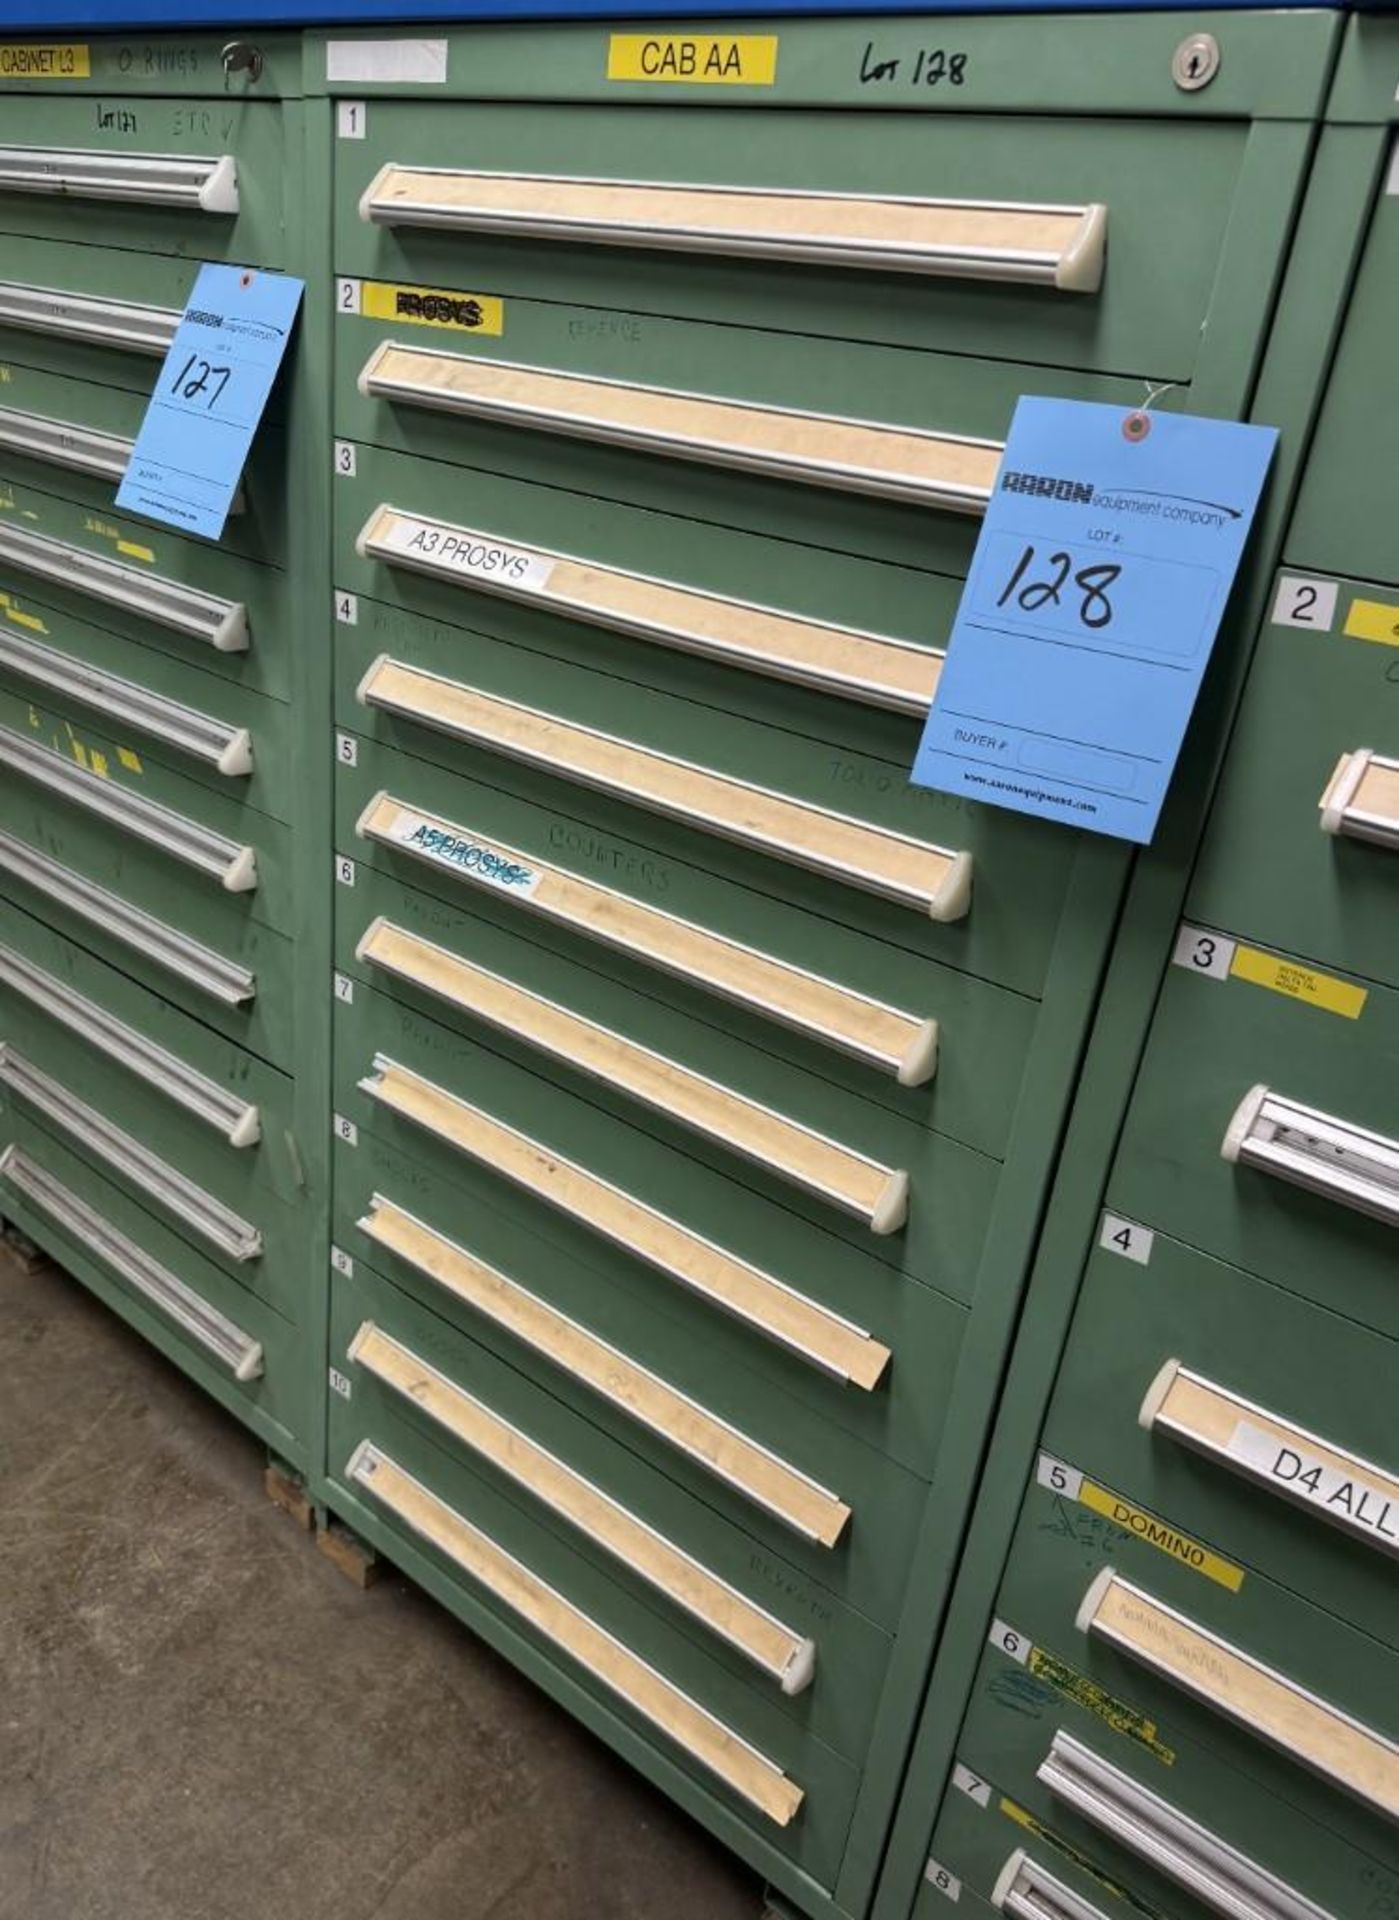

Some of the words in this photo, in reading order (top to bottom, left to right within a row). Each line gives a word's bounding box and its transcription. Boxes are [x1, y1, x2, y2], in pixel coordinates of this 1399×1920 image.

[1, 49, 54, 73] CABINET
[59, 48, 75, 73] L3
[641, 42, 695, 74] CAB
[704, 44, 741, 76] AA
[913, 50, 967, 85] 128
[349, 106, 358, 134] 1
[343, 284, 353, 309] 2
[171, 353, 231, 410] 127
[342, 447, 352, 472] 3
[1001, 471, 1094, 505] AARON
[1093, 492, 1162, 519] equipment
[1162, 505, 1226, 527] company
[408, 530, 440, 552] A3
[439, 536, 529, 579] PROSYS
[997, 545, 1123, 629] 128
[340, 599, 350, 619] 4
[1291, 586, 1318, 622] 2
[342, 740, 353, 762] 5
[954, 729, 996, 750] BUYER
[342, 863, 352, 882] 6
[1193, 938, 1216, 968] 3
[339, 979, 349, 997] 7
[342, 1121, 351, 1138] 8
[1112, 1228, 1132, 1251] 4
[332, 1373, 348, 1393] 10
[1050, 1466, 1067, 1489] 5
[1271, 1448, 1323, 1494] D4
[1326, 1482, 1396, 1537] ALL
[1003, 1632, 1020, 1653] 6
[967, 1776, 983, 1793] 7
[935, 1870, 950, 1889] 8
